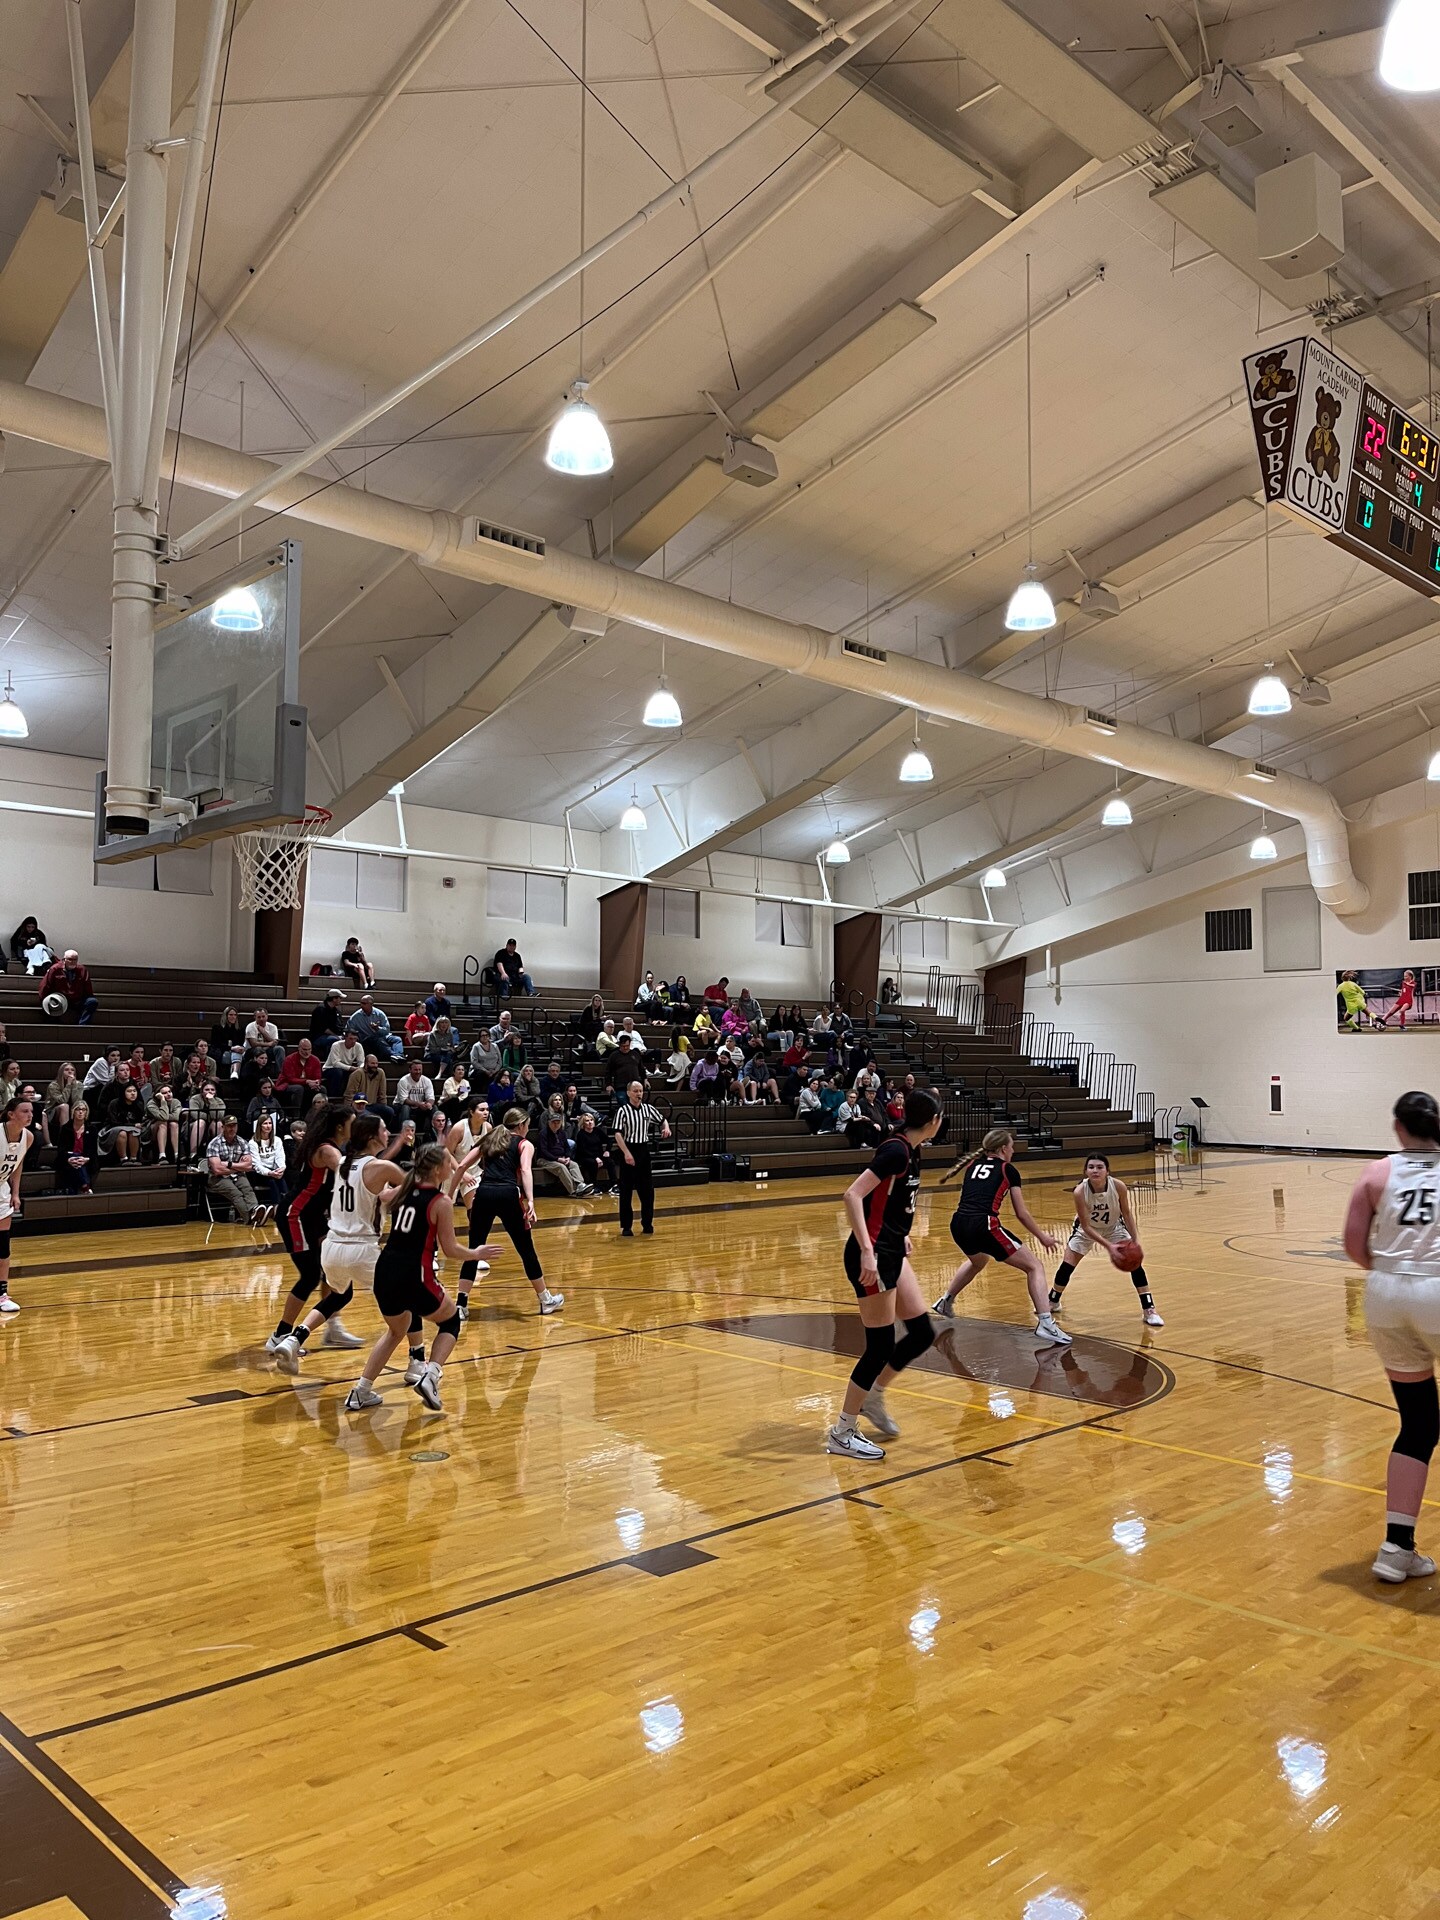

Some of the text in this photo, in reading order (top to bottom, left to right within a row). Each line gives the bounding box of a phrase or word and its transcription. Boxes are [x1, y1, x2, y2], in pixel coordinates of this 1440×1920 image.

[1309, 345, 1360, 393] MOUNT CARMEL
[1317, 369, 1349, 400] ACADEMY
[1366, 391, 1387, 419] HOME
[1262, 403, 1289, 497] CUBS
[1363, 416, 1386, 459] 22
[1400, 421, 1437, 474] 6:31
[1365, 460, 1382, 481] BONUS
[1395, 472, 1413, 493] PERIOD
[1292, 467, 1344, 523] CUBS
[1359, 480, 1376, 500] FOULS
[1415, 483, 1423, 508] 4
[1363, 500, 1374, 529] 0
[1389, 500, 1424, 532] PLAYER FOULS
[4, 1154, 18, 1162] MCA
[971, 1164, 994, 1180] 15
[339, 1185, 354, 1213] 10
[1093, 1203, 1109, 1211] MCA
[1398, 1188, 1436, 1226] 25
[394, 1204, 416, 1233] 10
[1091, 1211, 1110, 1224] 24
